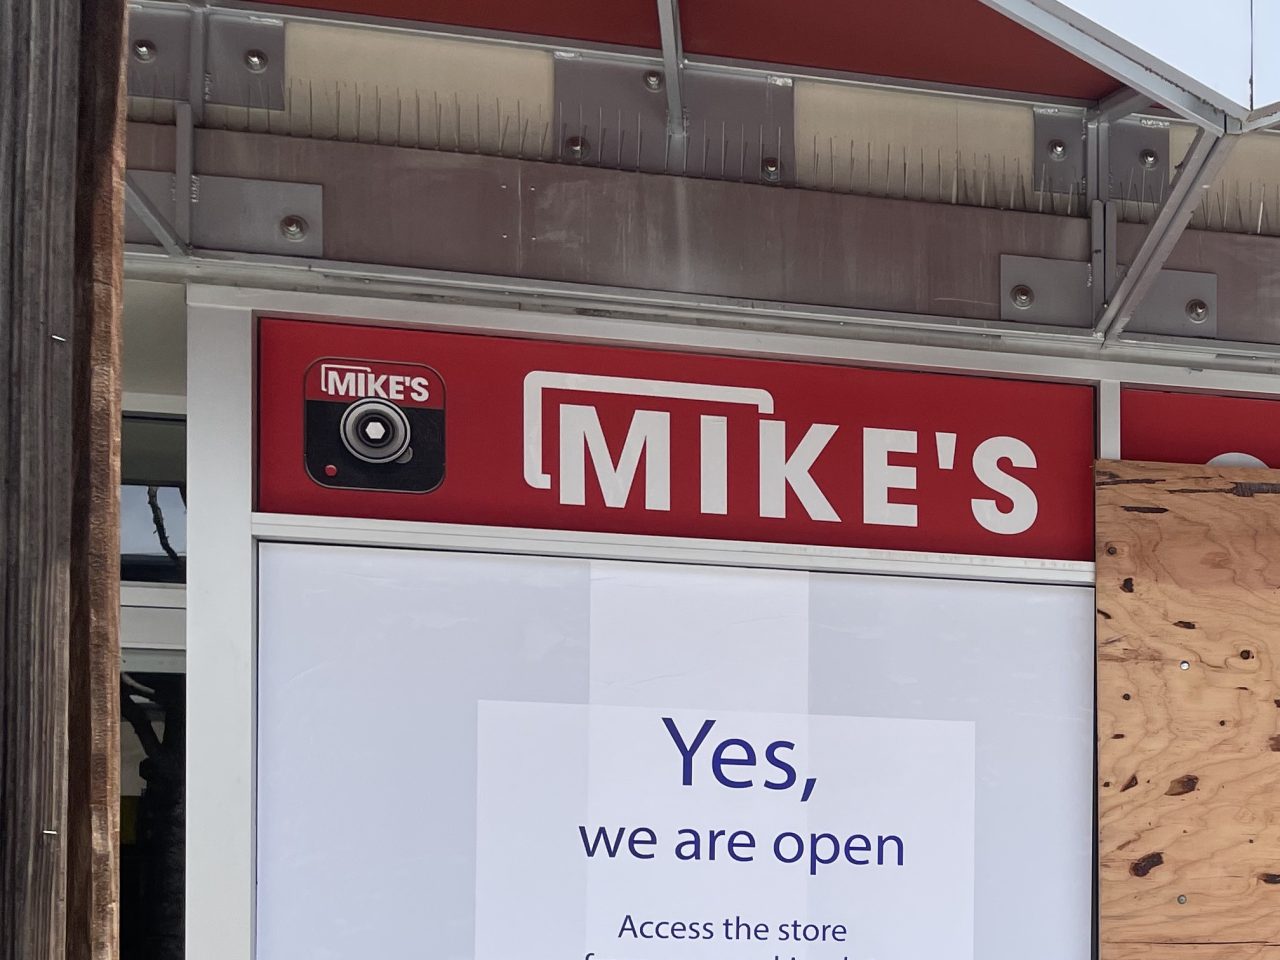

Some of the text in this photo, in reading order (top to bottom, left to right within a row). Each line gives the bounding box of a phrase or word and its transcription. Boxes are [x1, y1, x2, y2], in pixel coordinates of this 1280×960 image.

[327, 370, 430, 402] MIKE'S
[559, 403, 1039, 536] MIKE'S
[661, 717, 818, 802] Yes,
[578, 824, 905, 876] we are open
[617, 914, 848, 943] Access the store
